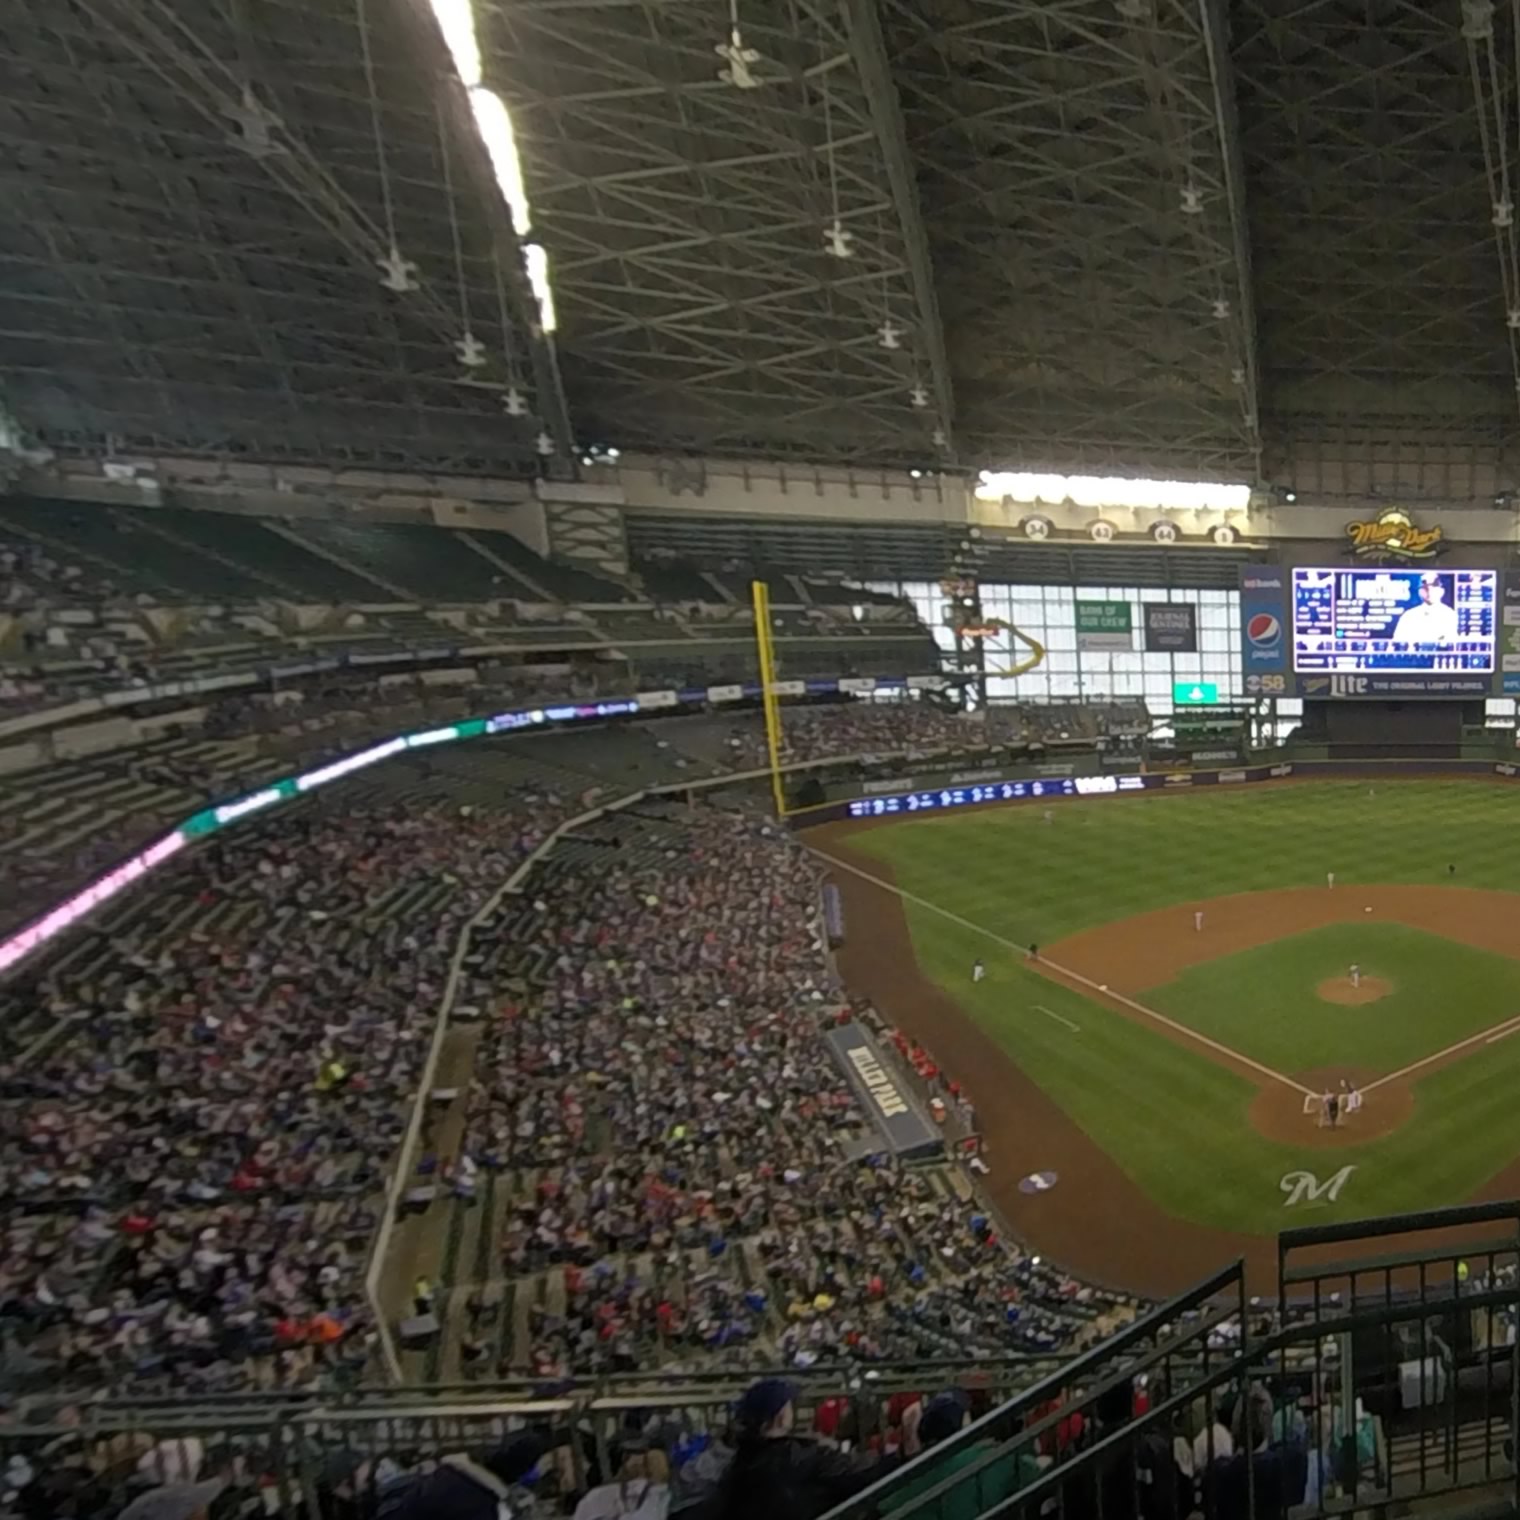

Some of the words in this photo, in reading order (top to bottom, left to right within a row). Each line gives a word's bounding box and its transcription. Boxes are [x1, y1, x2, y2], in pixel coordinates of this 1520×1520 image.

[1346, 521, 1402, 545] Miller
[1397, 526, 1441, 551] Park
[1262, 674, 1285, 690] 58
[1330, 674, 1368, 696] Lite
[1280, 1165, 1358, 1206] M
